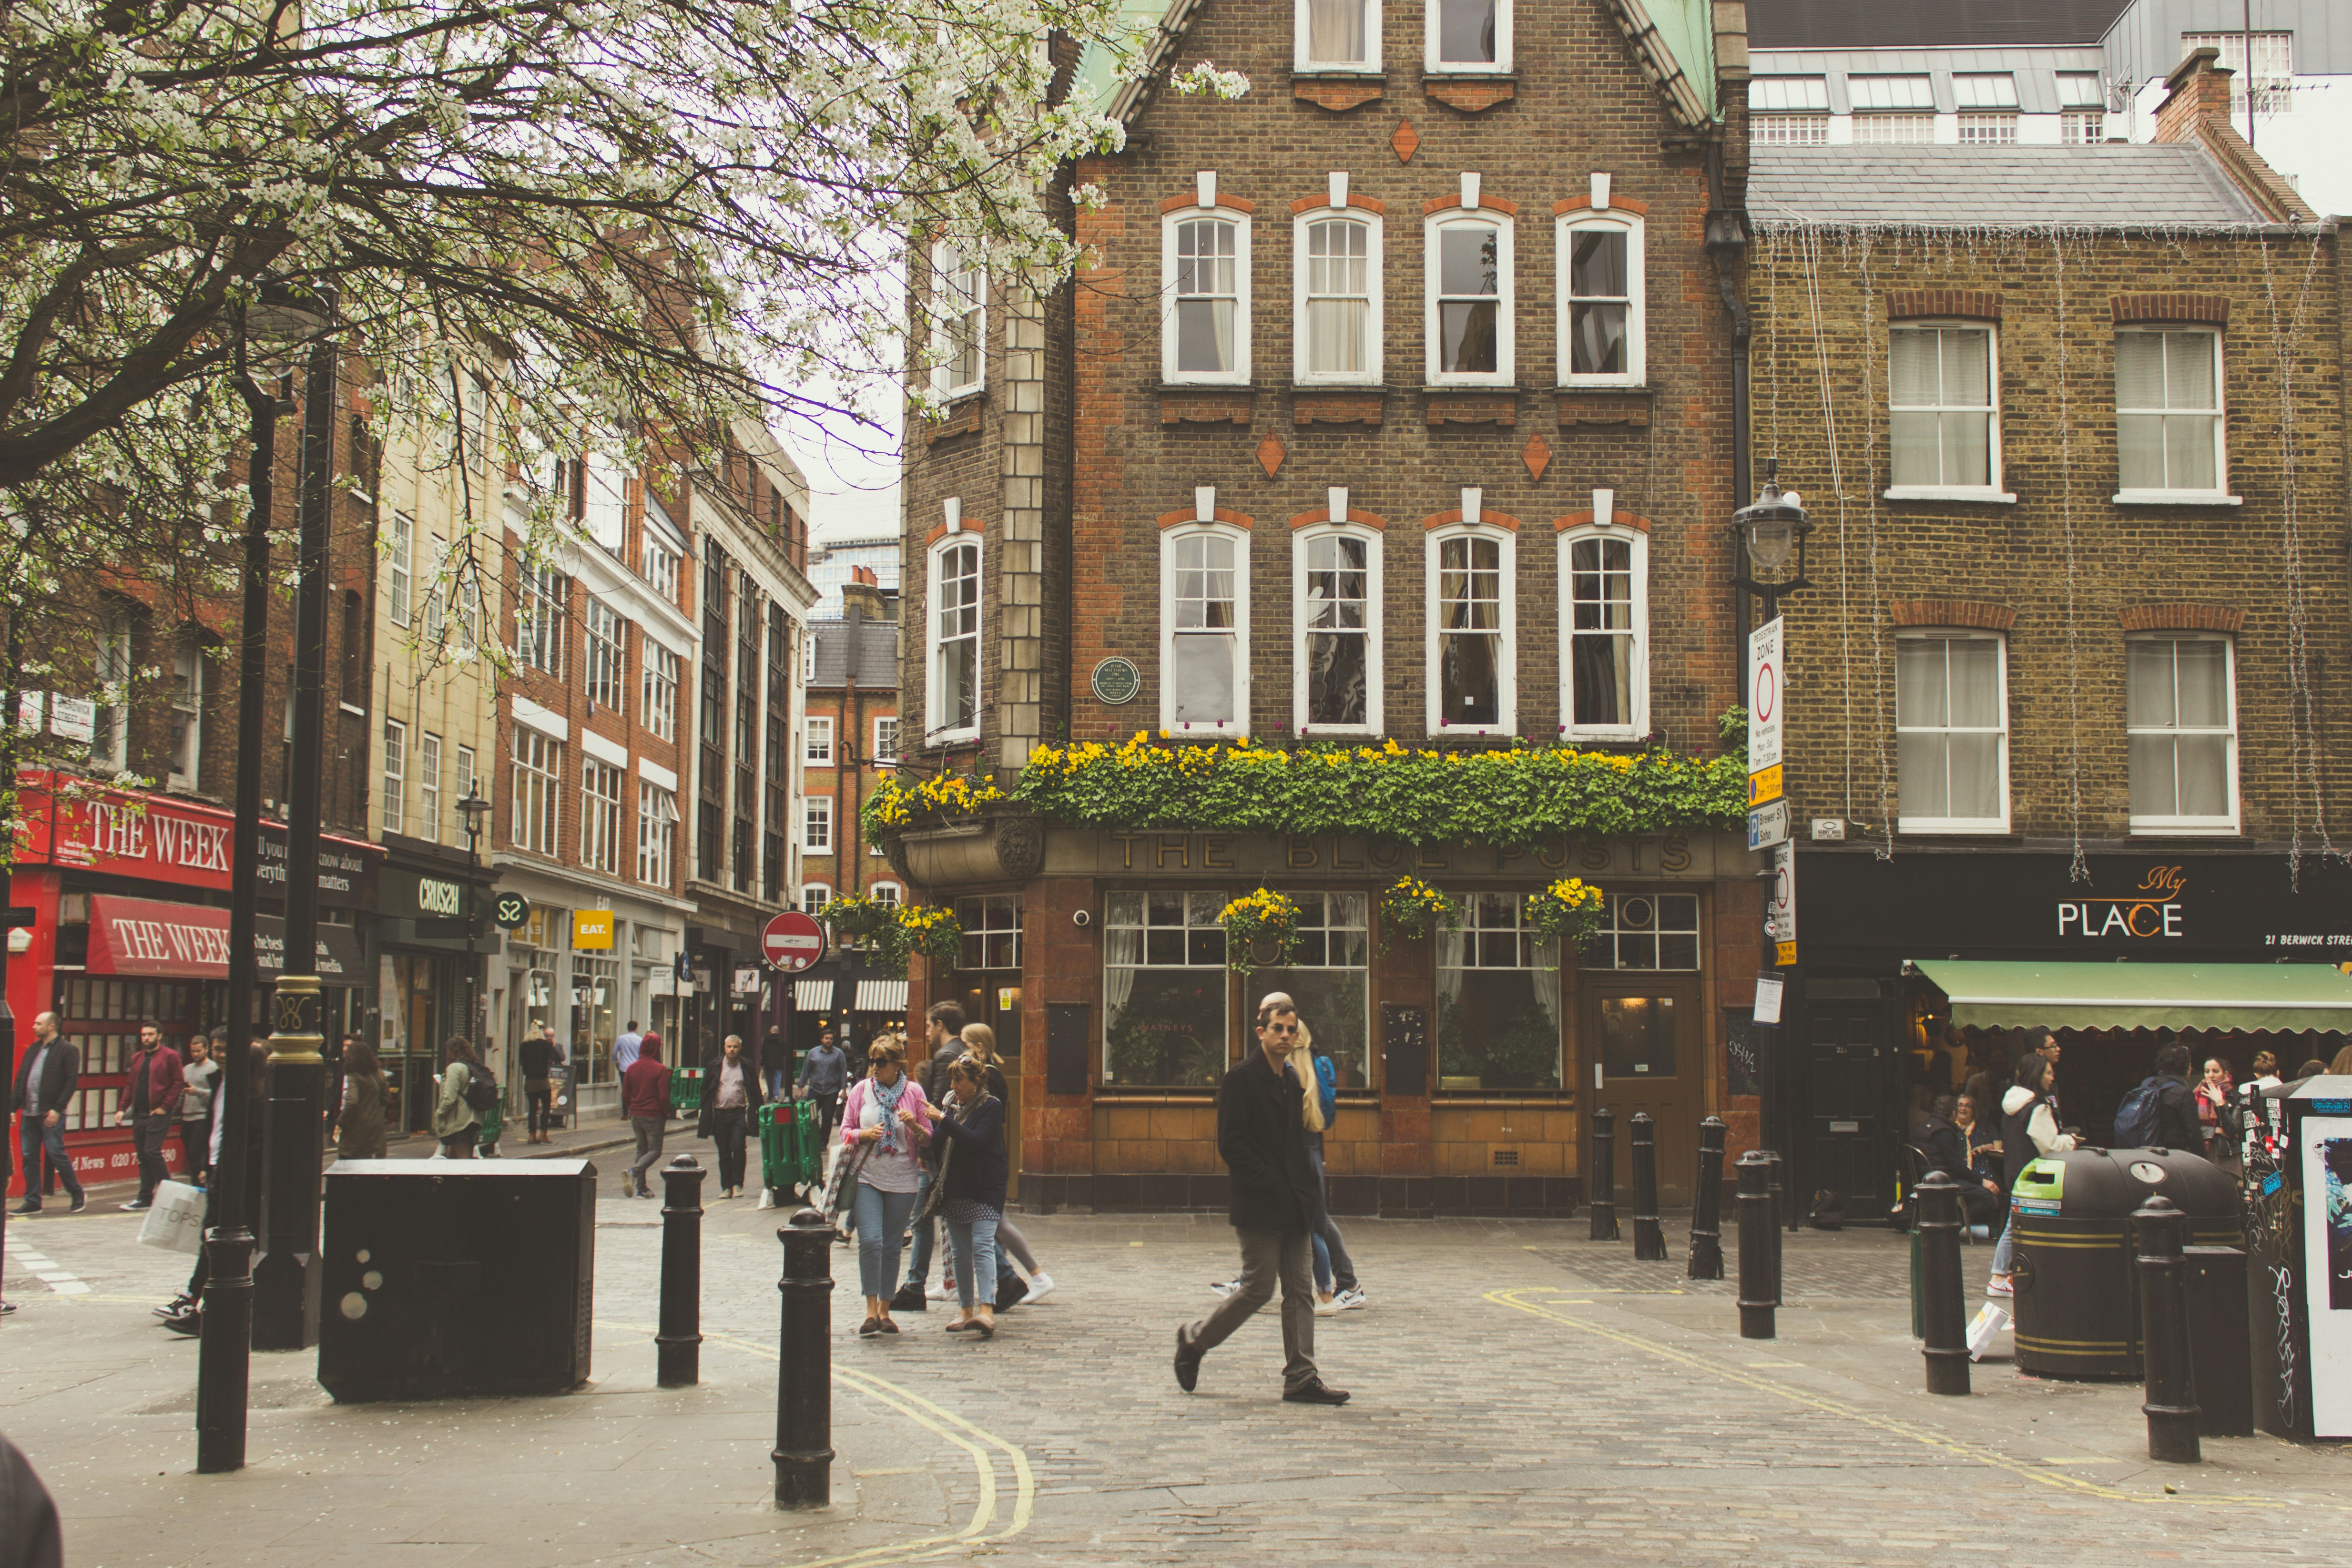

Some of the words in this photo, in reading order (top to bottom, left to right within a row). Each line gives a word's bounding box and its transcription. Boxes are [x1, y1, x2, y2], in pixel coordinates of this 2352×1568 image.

[1753, 623, 1778, 643] PEDESTRIAN
[1757, 639, 1773, 661] ZONE
[1761, 724, 1775, 736] vehicles
[1760, 813, 1775, 825] Brewer
[1776, 808, 1782, 820] St
[86, 801, 147, 859] THE
[152, 814, 229, 871] WEEK
[1760, 830, 1771, 842] Soho
[265, 843, 283, 860] you
[340, 853, 363, 873] about
[1112, 835, 1234, 869] THE
[1287, 835, 1447, 869] BLUE
[1497, 835, 1691, 872] POSTS
[1776, 852, 1788, 865] ZONE
[318, 875, 349, 892] matters
[2138, 866, 2187, 901] My
[2058, 903, 2183, 937] PLACE
[580, 924, 606, 935] EAT.
[112, 918, 170, 960] THE
[164, 923, 231, 964] WEEK
[265, 935, 284, 951] best
[2265, 935, 2276, 945] 21
[2280, 935, 2324, 945] BERWICK
[2326, 935, 2352, 945] STRE
[1139, 1024, 1193, 1032] WATNEYS
[80, 1156, 105, 1170] News
[111, 1153, 130, 1168] 020
